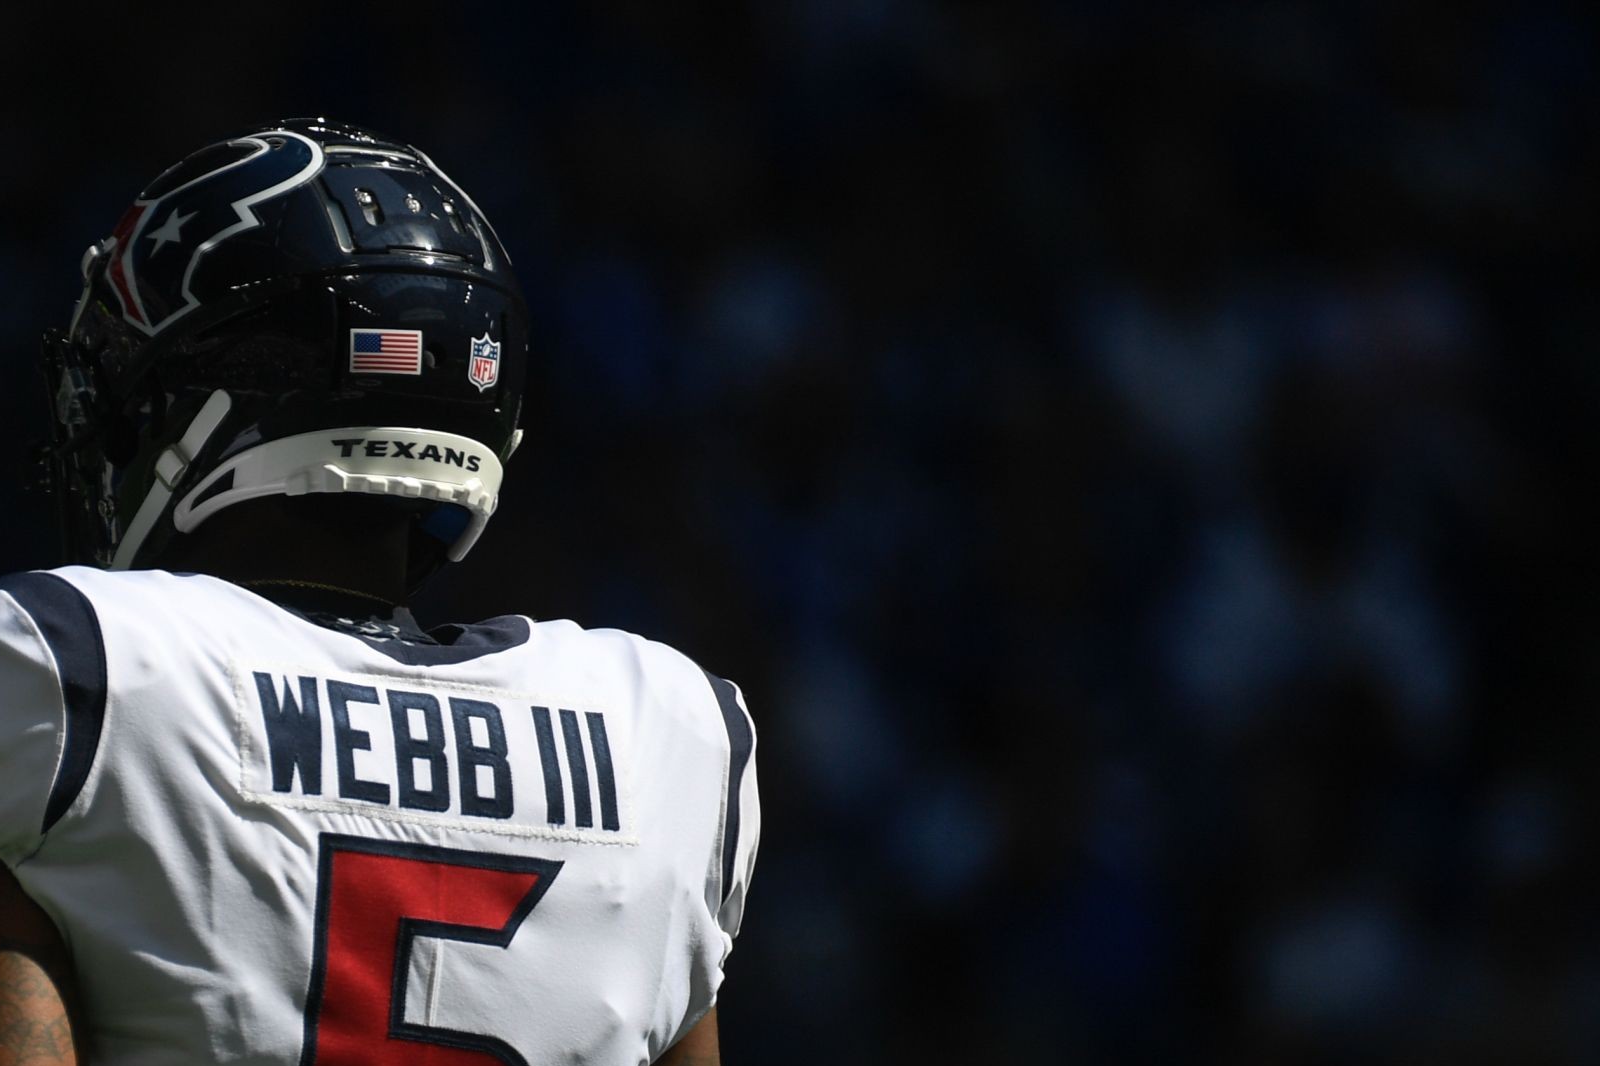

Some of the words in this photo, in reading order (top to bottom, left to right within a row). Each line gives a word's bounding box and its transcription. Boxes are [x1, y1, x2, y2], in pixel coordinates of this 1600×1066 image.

[473, 358, 495, 382] NFL
[332, 439, 481, 472] TEXANS
[253, 671, 515, 820] WEBB
[531, 706, 620, 831] III
